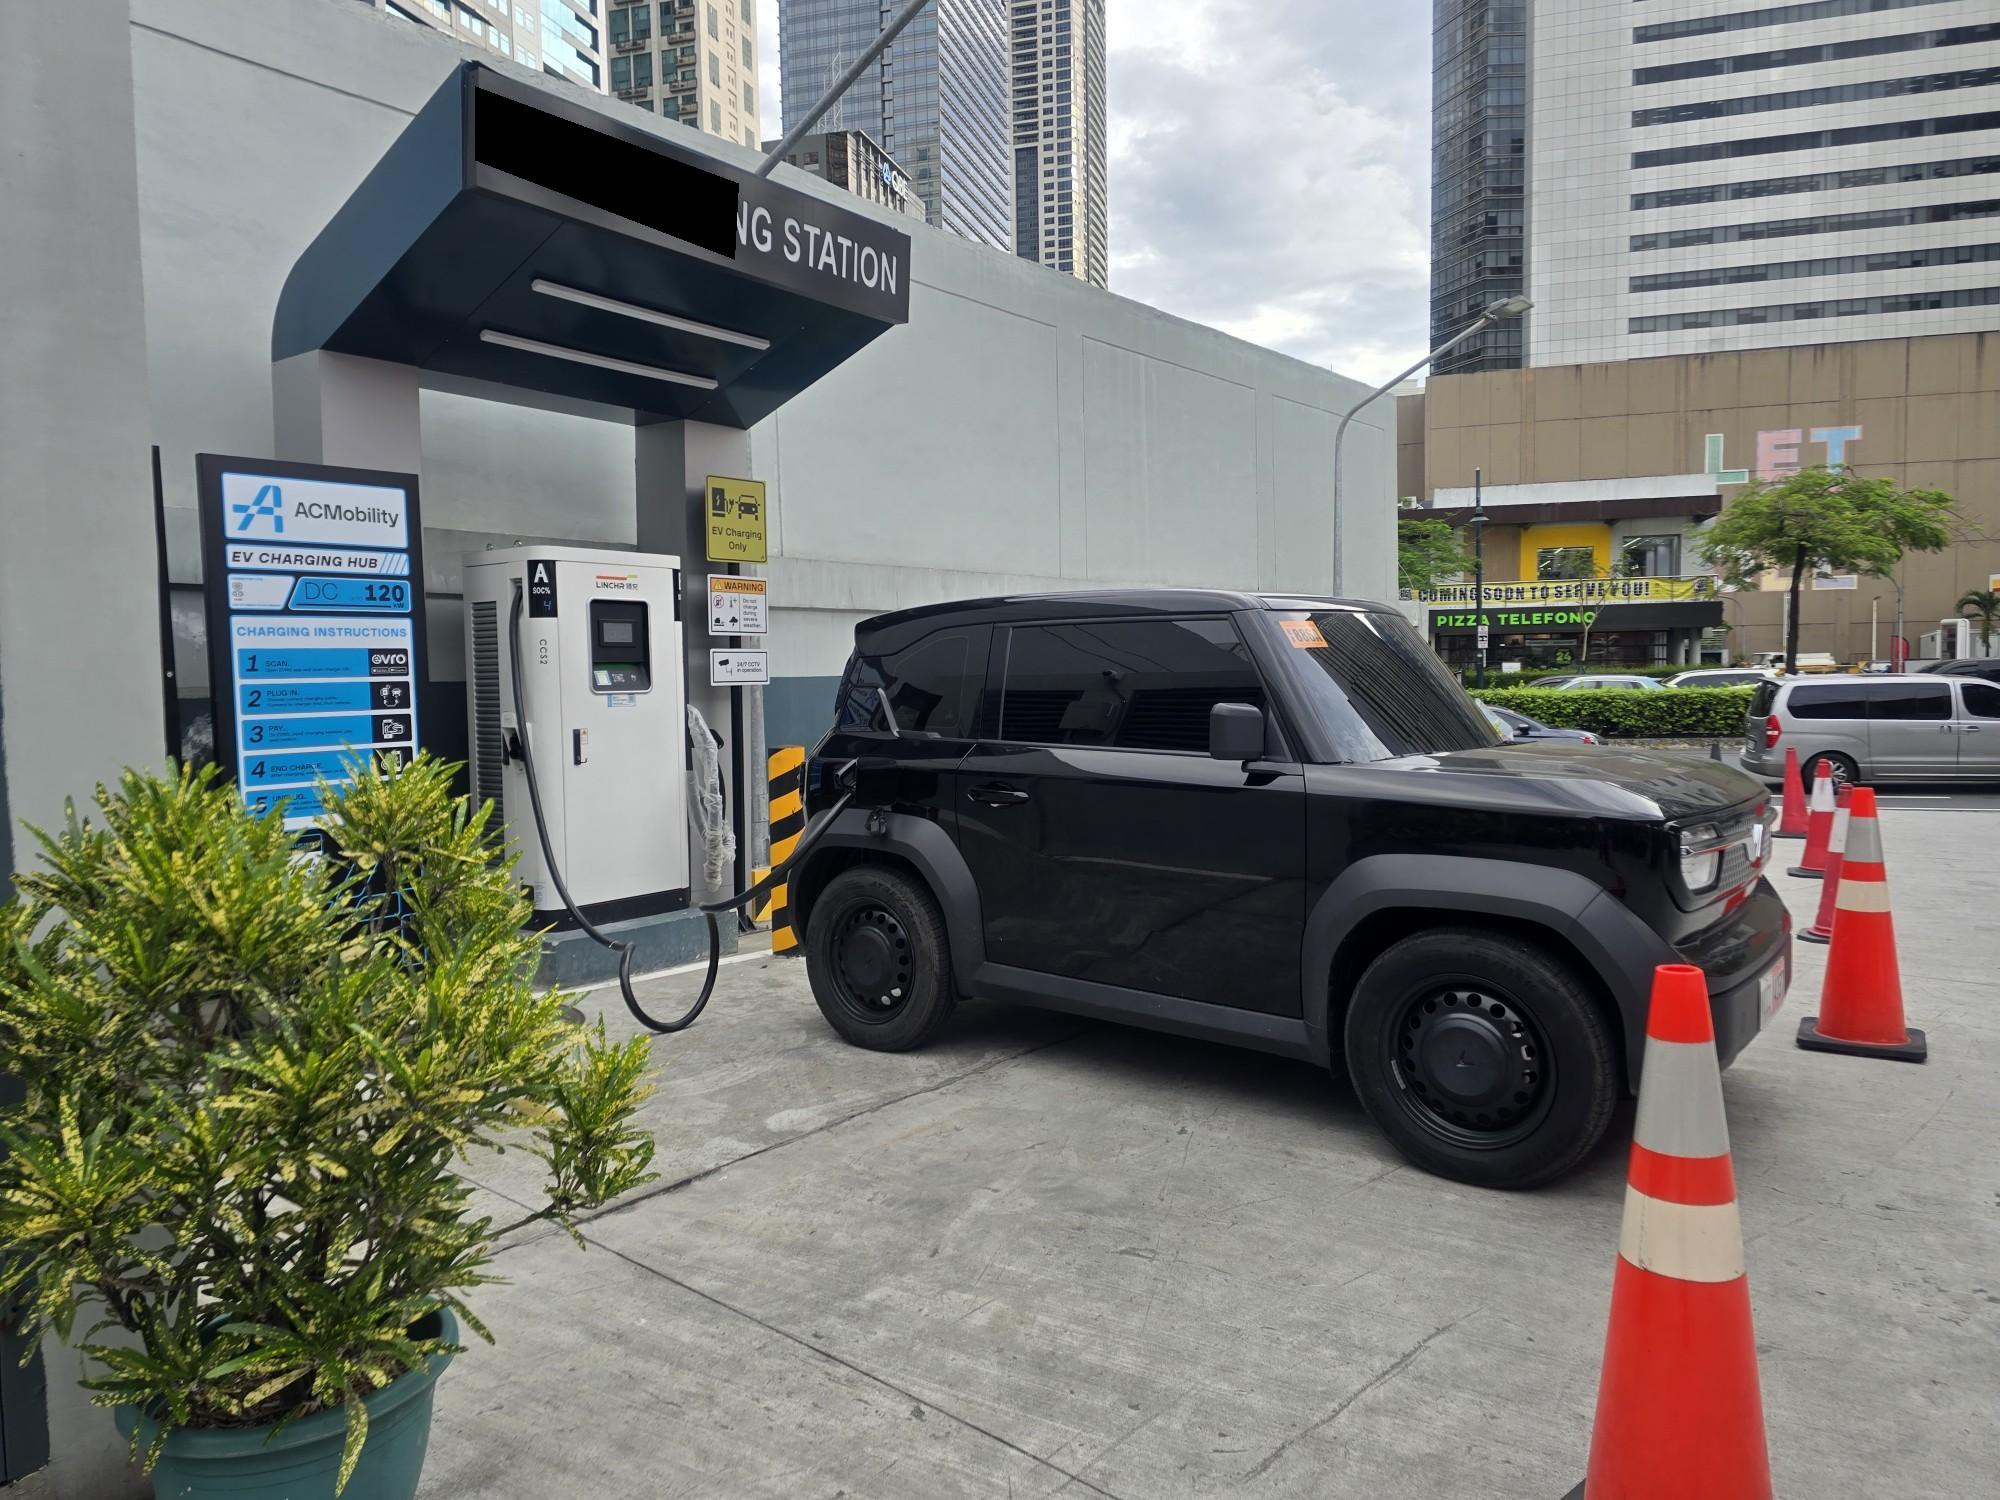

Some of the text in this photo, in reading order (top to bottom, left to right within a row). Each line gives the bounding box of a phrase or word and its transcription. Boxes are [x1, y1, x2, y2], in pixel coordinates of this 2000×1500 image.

[783, 217, 898, 295] STATION
[294, 501, 399, 528] ACMobility
[712, 527, 762, 541] EV Charging
[728, 541, 747, 552] Only
[231, 551, 378, 569] EV CHARGING HUB
[534, 562, 549, 583] A
[304, 582, 405, 602] DC 120
[532, 586, 551, 595] SOC%
[723, 581, 764, 593] WARNING
[1419, 587, 1478, 602] COMING
[1483, 587, 1524, 600] SOON
[1530, 585, 1550, 599] TO
[1610, 581, 1650, 597] YOU!
[1437, 611, 1597, 627] PIZZA TELEFONO
[236, 626, 407, 638] CHARGING INSTRUCTIONS
[539, 638, 548, 665] CCS2
[246, 654, 259, 672] 1
[371, 653, 407, 665] evro
[247, 690, 262, 708] 2
[249, 725, 264, 743] 3
[251, 761, 266, 778] 4
[255, 796, 268, 813] 5
